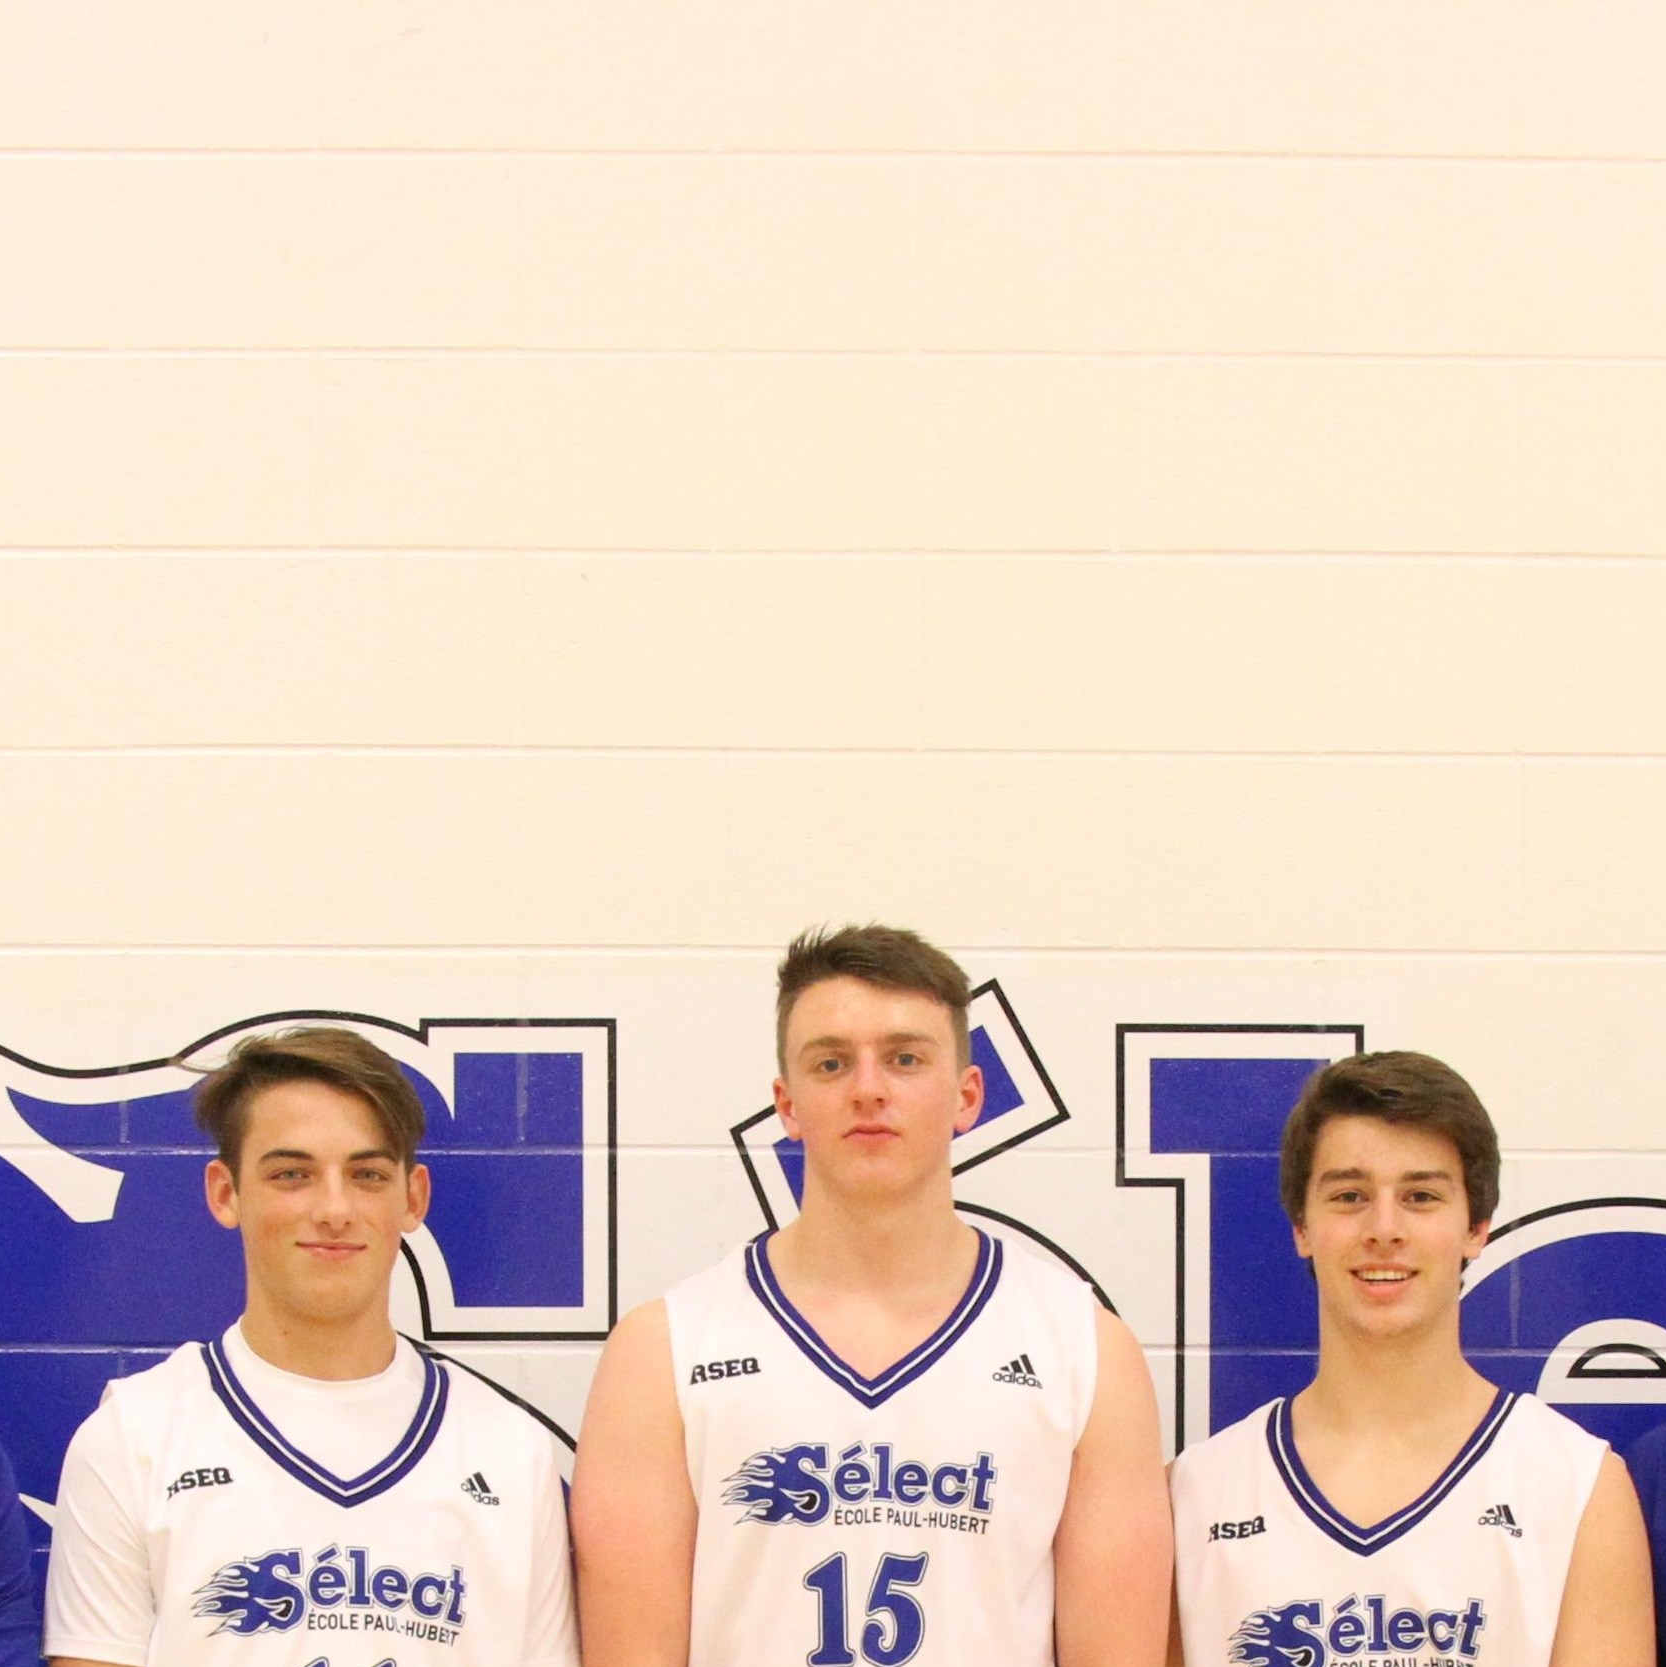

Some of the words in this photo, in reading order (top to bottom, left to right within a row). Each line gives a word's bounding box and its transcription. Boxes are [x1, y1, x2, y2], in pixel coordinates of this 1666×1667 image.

[690, 1357, 761, 1385] RSEQ
[720, 1441, 998, 1527] Sélect
[834, 1505, 882, 1526] ÉCOLE
[887, 1508, 990, 1535] PAUL-HUBERT
[191, 1543, 467, 1638] Sélect
[307, 1609, 359, 1630] ÉCOLE
